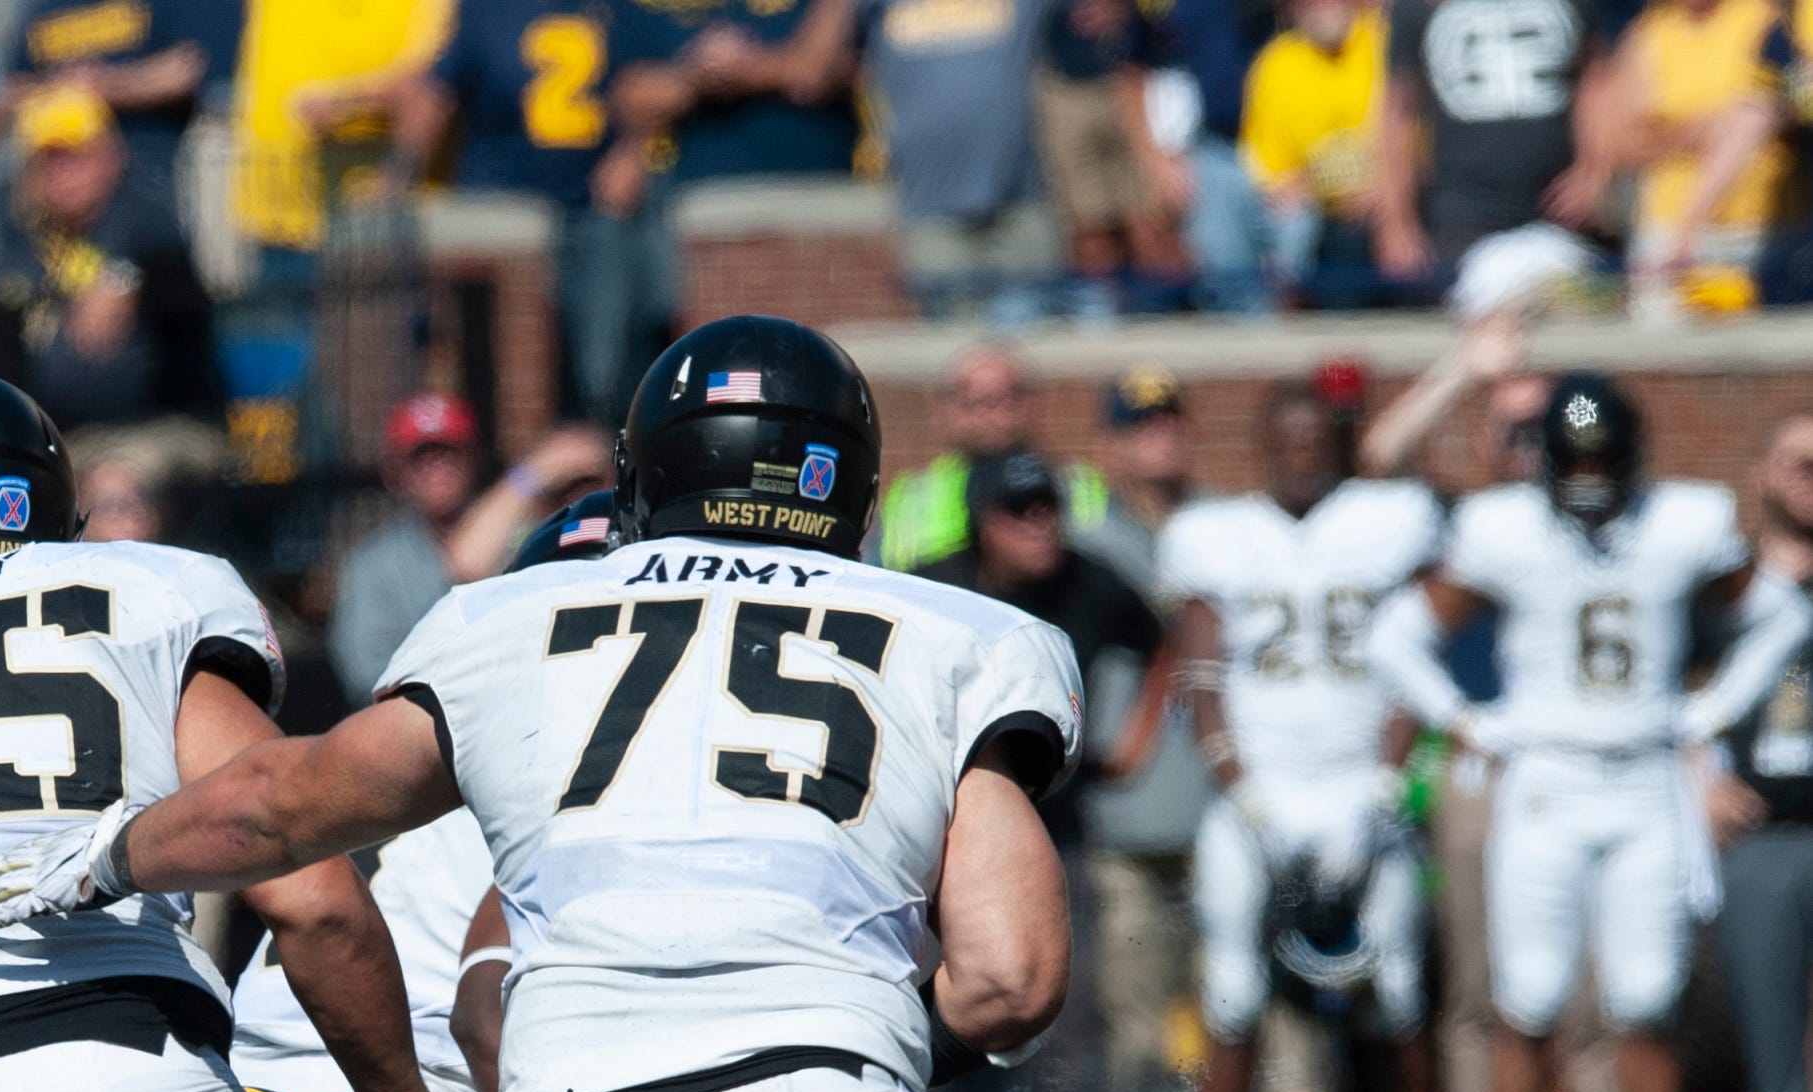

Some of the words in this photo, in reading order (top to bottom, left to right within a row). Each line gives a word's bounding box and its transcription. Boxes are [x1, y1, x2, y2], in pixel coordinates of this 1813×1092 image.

[520, 14, 607, 148] 2
[703, 501, 771, 529] WEST
[773, 506, 838, 539] POINT
[624, 553, 831, 588] ARMY
[1575, 597, 1635, 686] 6
[545, 596, 901, 827] 75
